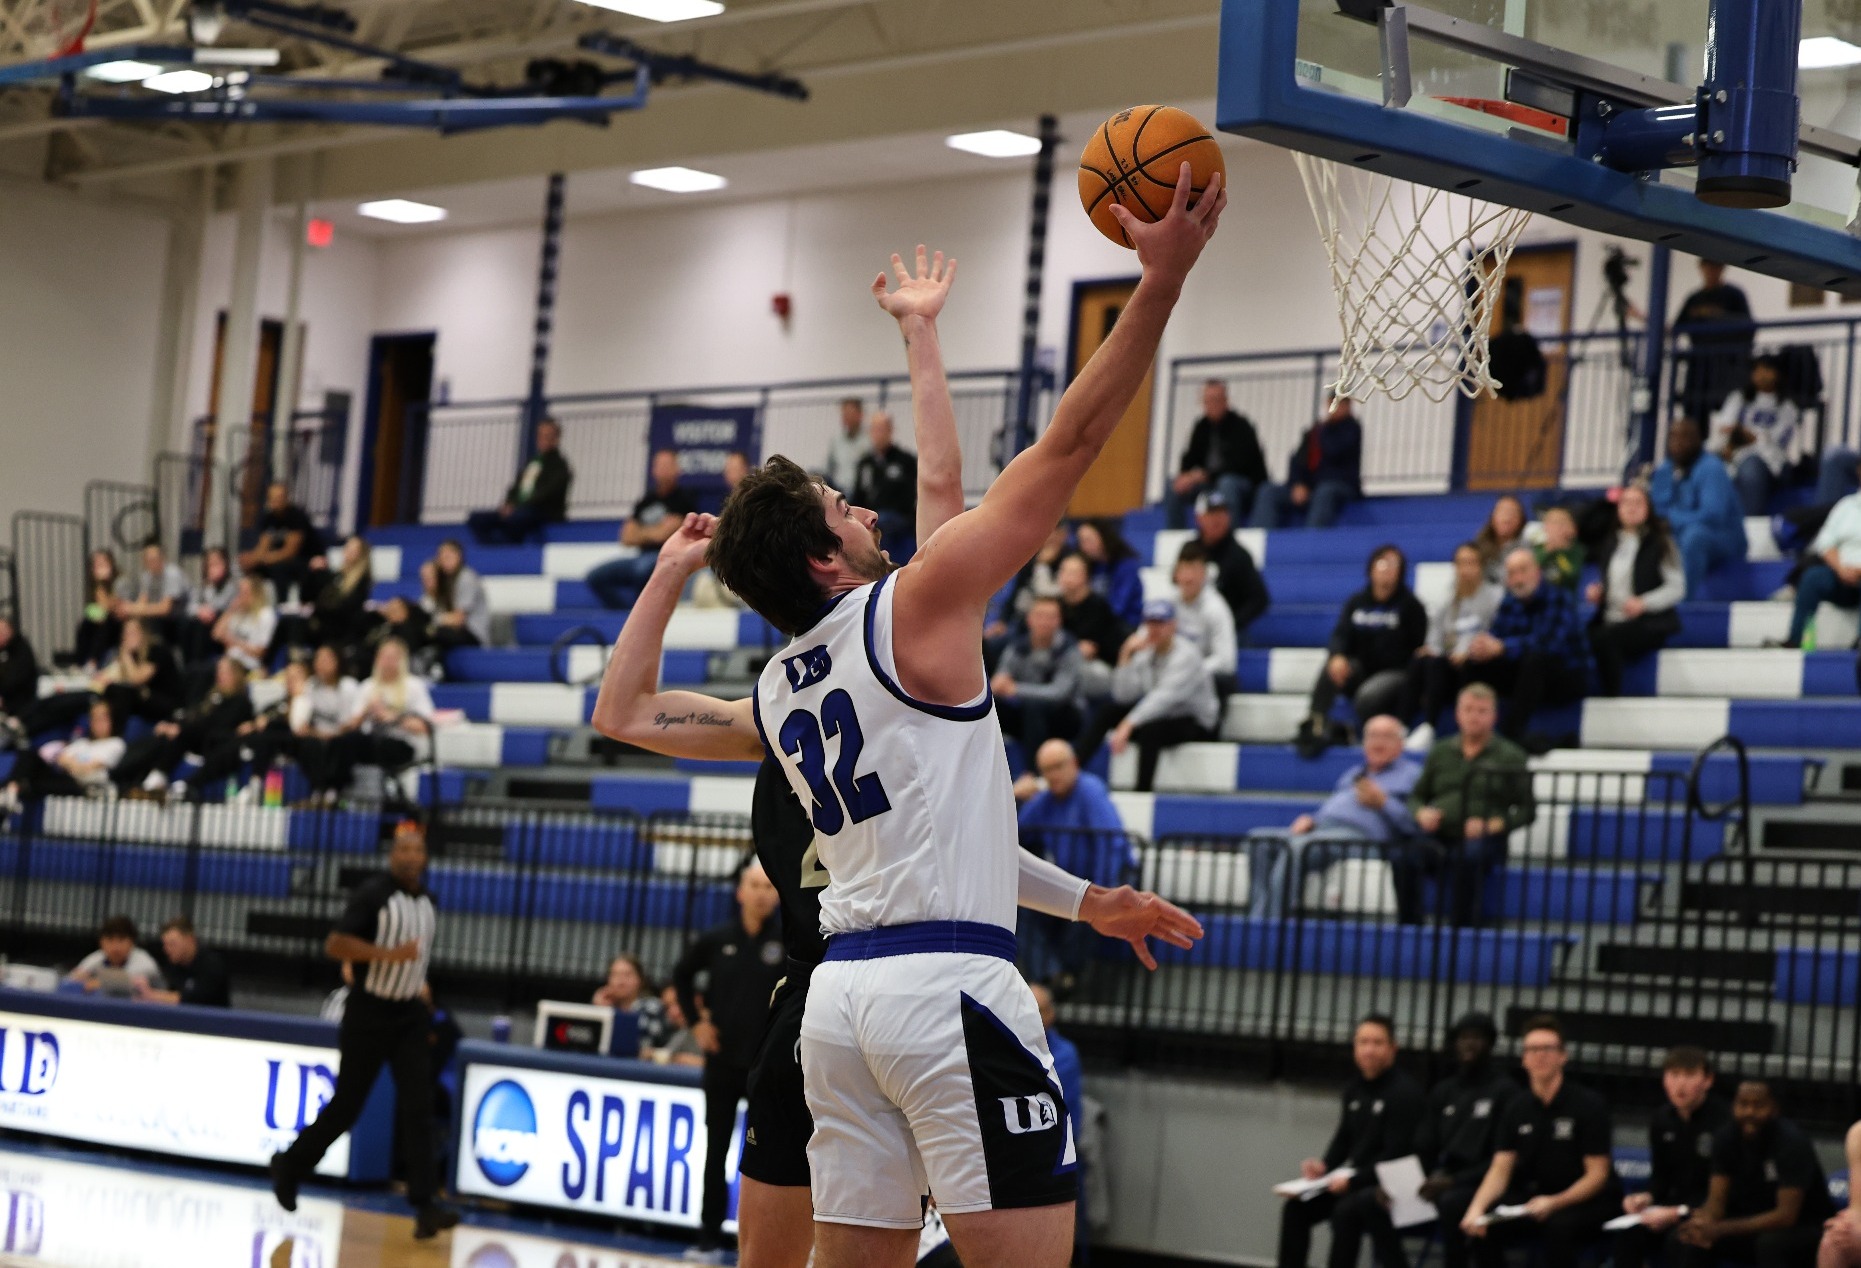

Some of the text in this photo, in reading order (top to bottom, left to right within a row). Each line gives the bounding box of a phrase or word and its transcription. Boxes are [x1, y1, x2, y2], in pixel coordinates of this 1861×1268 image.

[696, 712, 735, 727] Blessed
[779, 688, 892, 836] 32
[997, 1091, 1058, 1135] UD
